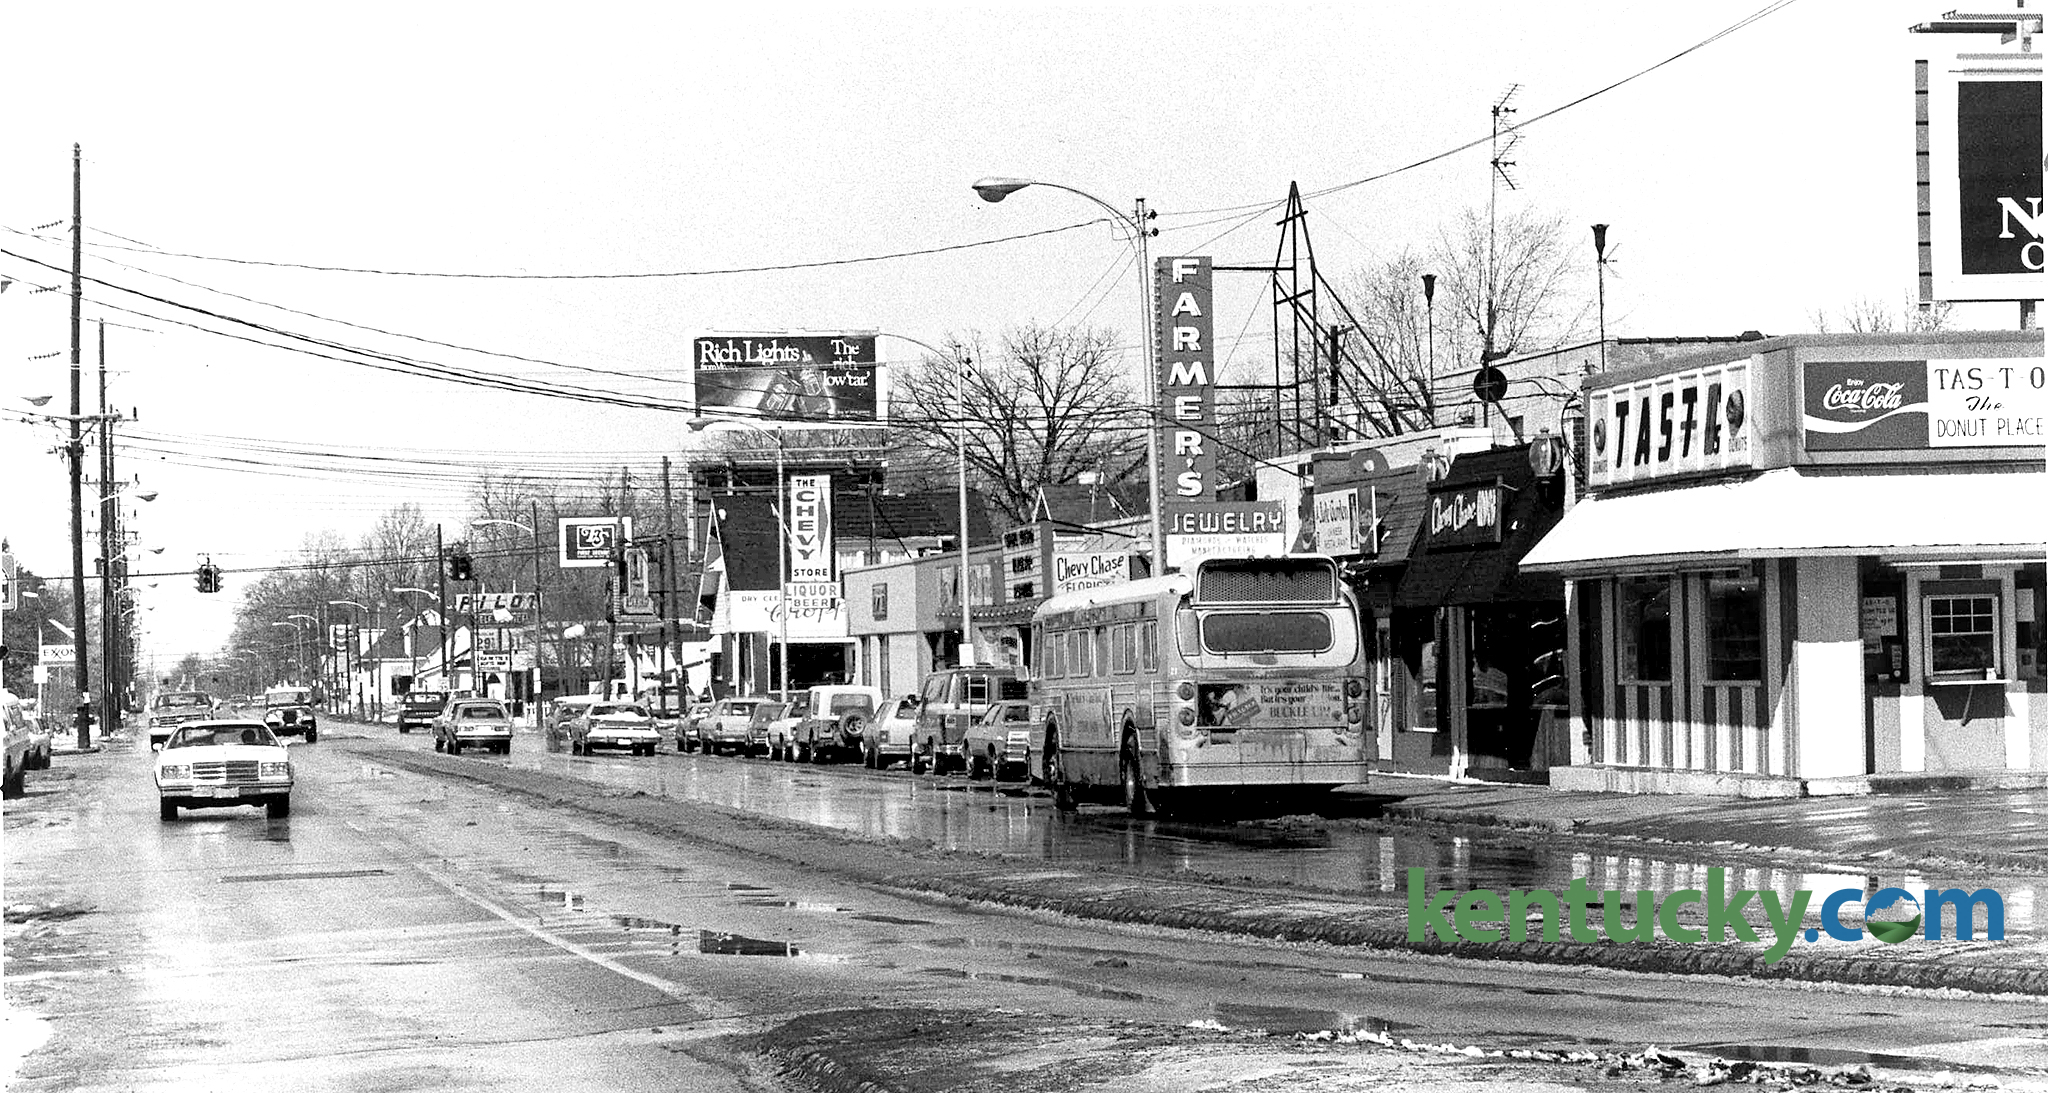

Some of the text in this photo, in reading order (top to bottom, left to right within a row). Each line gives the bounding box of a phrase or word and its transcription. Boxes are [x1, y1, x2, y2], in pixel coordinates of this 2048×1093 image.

[698, 340, 800, 365] Rich Lights
[831, 340, 859, 355] The
[833, 355, 858, 370] rich
[1168, 258, 1209, 497] FARMER'S
[1823, 383, 1904, 410] Coca-Cola
[1966, 396, 2003, 411] The
[1937, 418, 2043, 437] DONUT PLACE
[796, 491, 815, 560] CHEVY
[1169, 512, 1282, 533] JEWELRY
[1057, 557, 1088, 582] Chevy
[1091, 555, 1124, 575] Chase
[785, 585, 837, 596] LIQUOR
[794, 599, 828, 607] BEER
